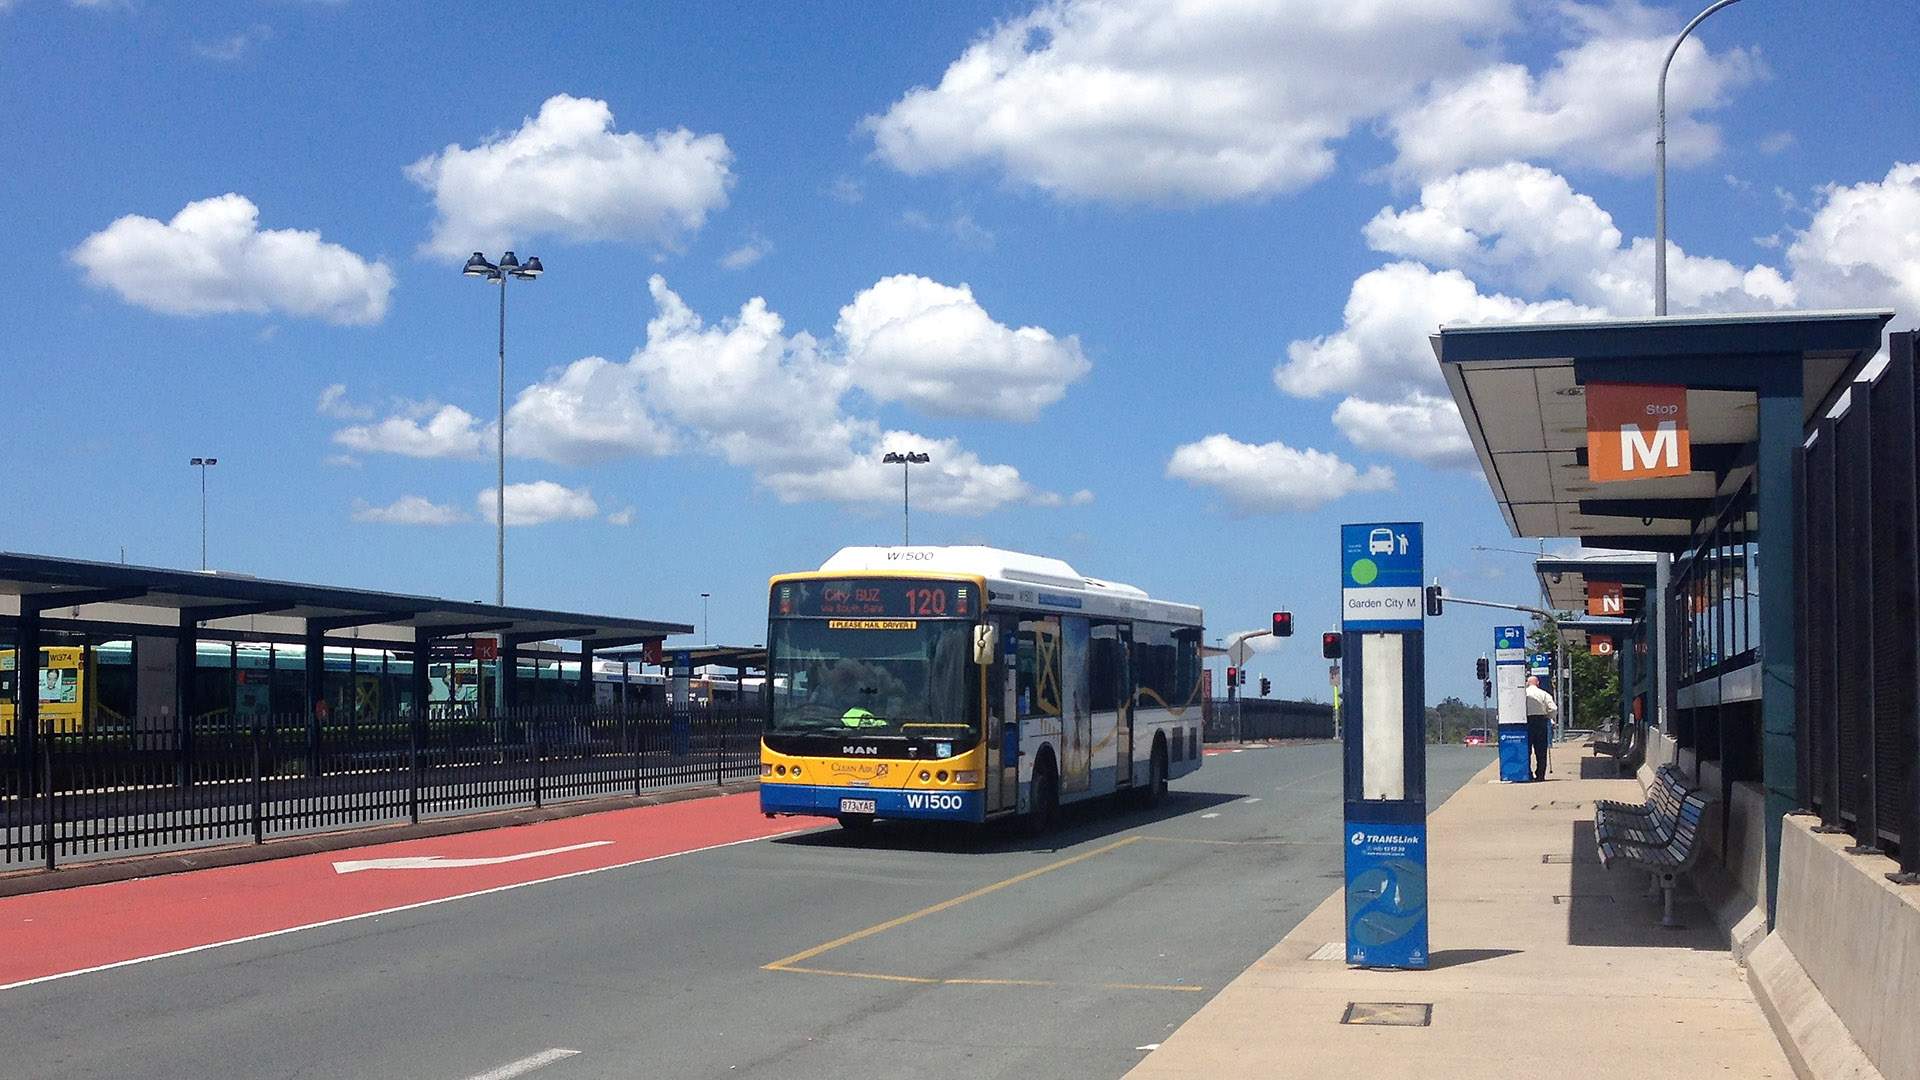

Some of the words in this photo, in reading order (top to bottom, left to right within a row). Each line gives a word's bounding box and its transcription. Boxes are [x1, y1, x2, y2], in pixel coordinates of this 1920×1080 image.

[1646, 404, 1679, 416] Stop
[1620, 420, 1679, 471] M
[887, 551, 934, 561] W1500
[906, 588, 946, 615] 120
[1348, 599, 1382, 608] Garden
[1385, 598, 1405, 609] City
[1407, 598, 1416, 607] M
[1603, 594, 1620, 612] N
[483, 647, 491, 657] K
[843, 746, 878, 755] MAN
[907, 794, 962, 810] W1500
[1366, 835, 1419, 844] TRANSLink
